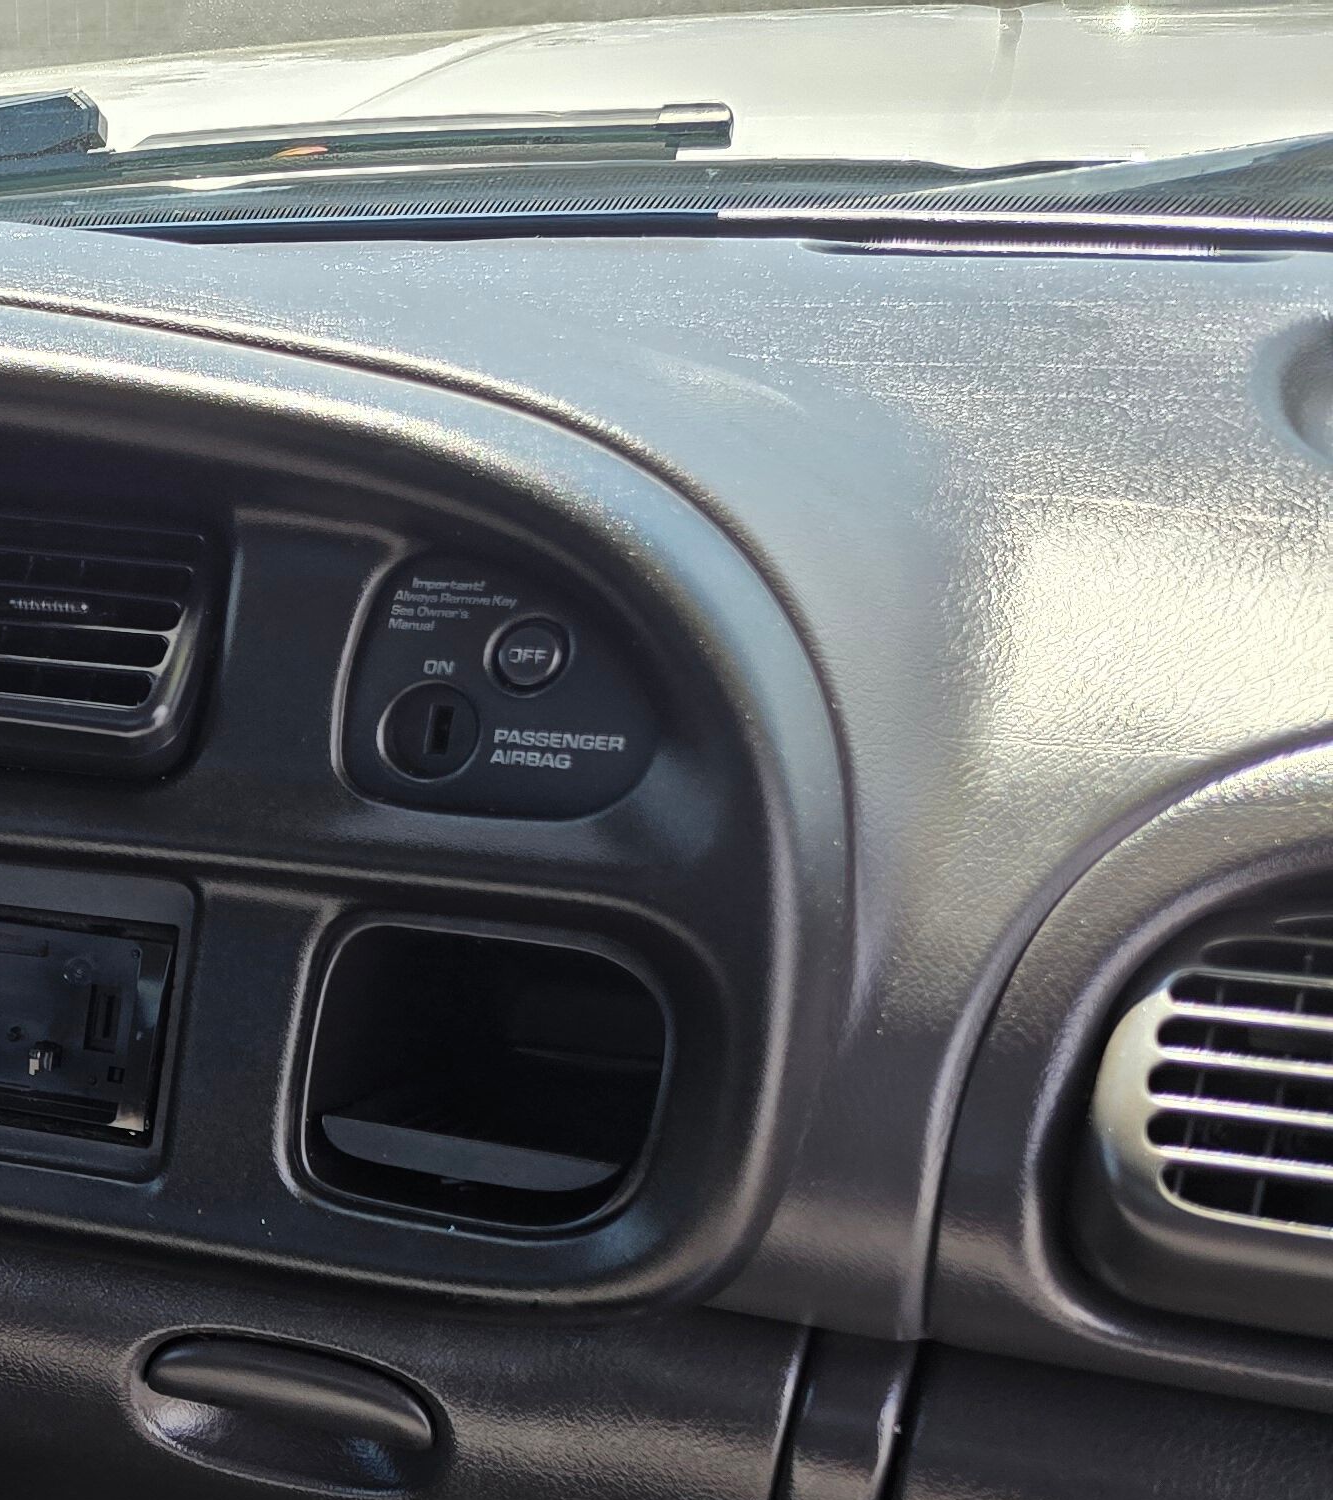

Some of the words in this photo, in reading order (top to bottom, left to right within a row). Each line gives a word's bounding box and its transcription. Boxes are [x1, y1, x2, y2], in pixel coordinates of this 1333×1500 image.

[492, 595, 517, 609] Key
[388, 618, 436, 631] Manual
[509, 648, 549, 665] OFF
[423, 660, 455, 676] ON
[493, 729, 626, 752] PASSENGER
[490, 749, 572, 769] AIRBAG
